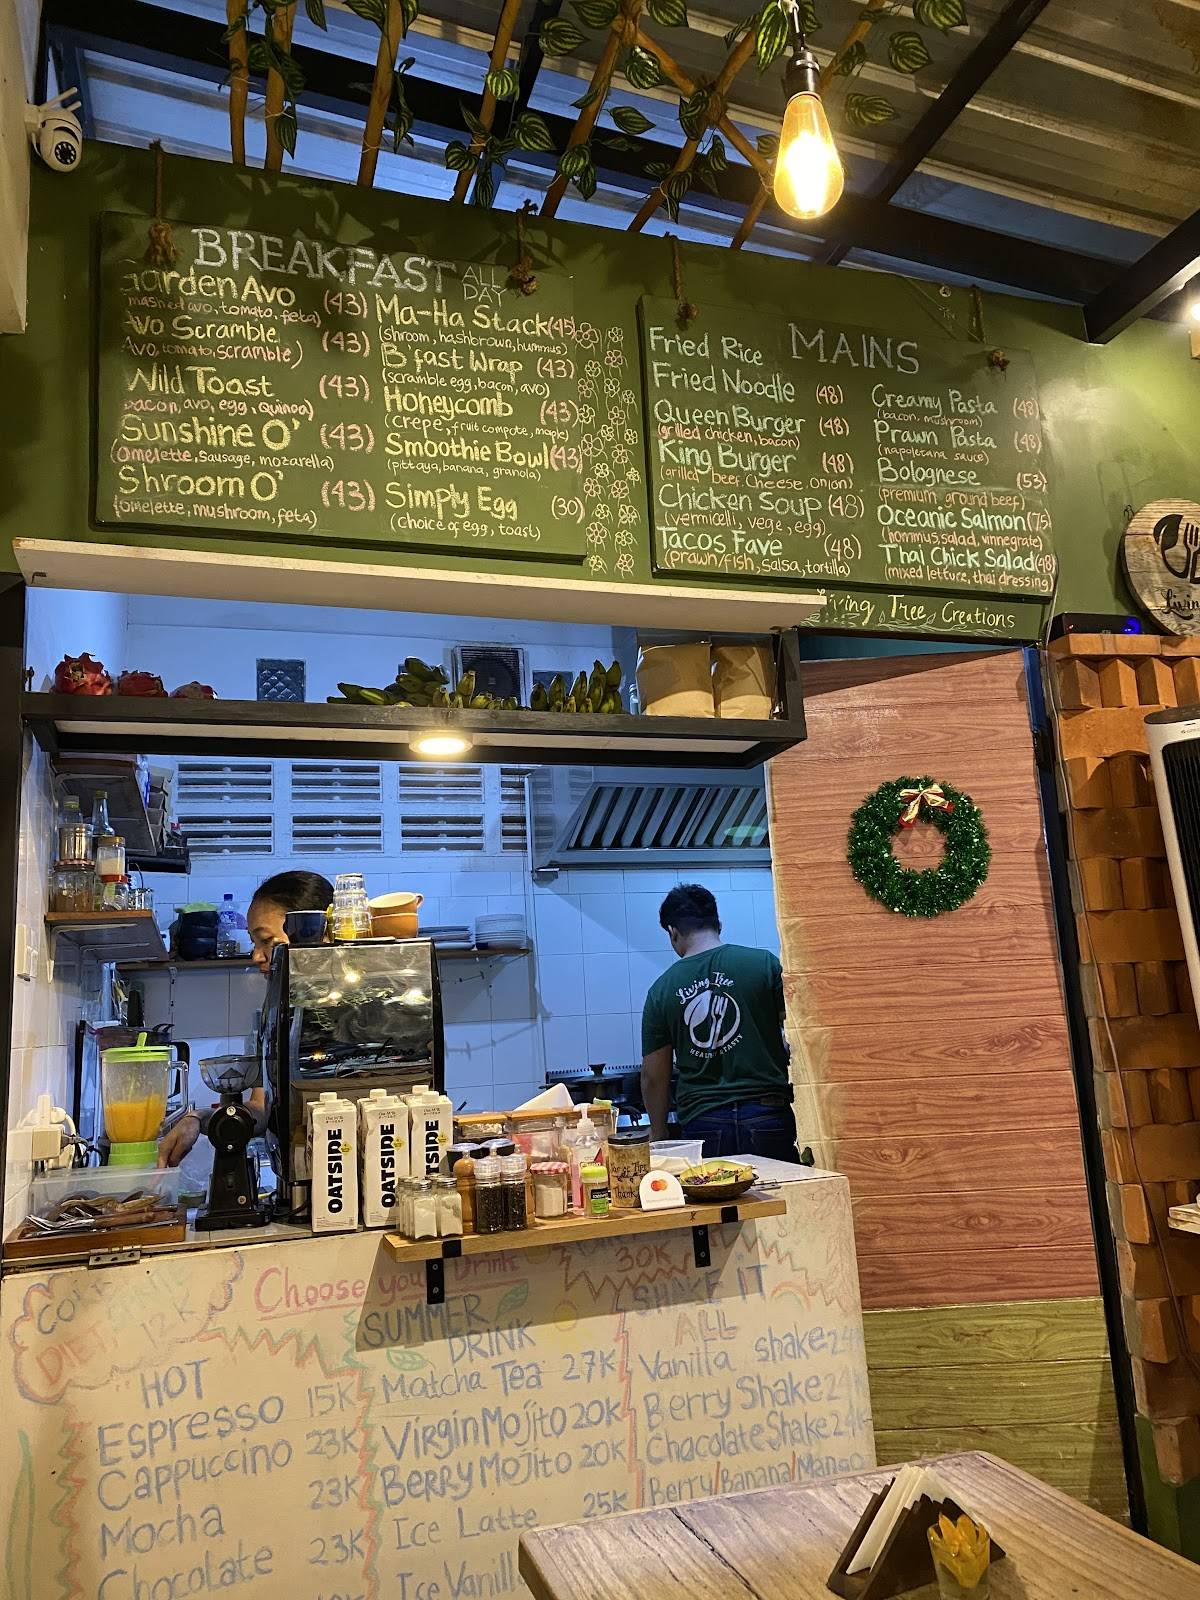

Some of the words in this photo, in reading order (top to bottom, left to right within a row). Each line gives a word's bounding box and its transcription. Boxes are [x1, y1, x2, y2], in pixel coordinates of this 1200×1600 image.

[191, 228, 456, 293] BREAKFAST
[461, 265, 501, 288] ALL
[241, 275, 296, 307] Avo
[323, 289, 368, 319] (43)
[463, 284, 508, 307] DAY
[376, 294, 466, 328] Ma-Ha
[472, 304, 548, 338] Stack
[547, 315, 577, 339] (45)
[171, 314, 280, 343] Scramble
[322, 331, 371, 359] (43)
[216, 340, 304, 369] scramble)
[378, 325, 438, 345] (shroom,
[517, 343, 568, 356] hummus)
[649, 327, 711, 359] Fried
[721, 336, 764, 367] Rice
[788, 322, 920, 375] MAINS
[184, 365, 276, 397] Toast
[319, 374, 371, 402] (43)
[382, 368, 448, 388] (scramble
[521, 382, 550, 399] avo)
[469, 349, 524, 384] Wrap
[536, 357, 575, 380] (43)
[652, 360, 718, 394] Fried
[722, 368, 796, 404] Noodle
[815, 384, 844, 406] (48)
[384, 385, 513, 420] Honeycomb
[539, 399, 579, 427] (43)
[653, 399, 729, 426] Queen
[732, 404, 806, 438] Burger
[818, 416, 850, 437] (48)
[872, 384, 942, 418] Creamy
[948, 388, 999, 415] Pasta
[1012, 397, 1041, 419] (48)
[121, 413, 256, 448] Sunshine
[319, 422, 375, 453] (43)
[384, 413, 451, 439] (crepe,
[451, 422, 480, 436] fruit
[657, 422, 701, 440] (grilled
[758, 435, 801, 451] bacon)
[874, 418, 939, 446] Prawn
[949, 425, 998, 449] Pasta
[1014, 430, 1042, 455] (48)
[924, 414, 984, 428] mushroom)
[259, 455, 335, 473] mozarella)
[385, 432, 492, 462] Smoothie
[495, 440, 549, 470] Bowl
[549, 446, 583, 474] (43)
[657, 440, 713, 475] King
[717, 442, 797, 478] Burger
[821, 451, 855, 475] (48)
[953, 450, 990, 466] sauce)
[118, 463, 245, 498] Shroom
[320, 479, 376, 512] (43)
[493, 466, 542, 482] granola)
[660, 465, 700, 482] (grilled
[877, 456, 982, 488] Bolognese
[1016, 471, 1048, 494] (53)
[385, 482, 470, 519] Simply
[477, 486, 518, 521] Egg
[551, 495, 586, 524] (30)
[658, 483, 753, 512] Chicken
[758, 491, 823, 524] Soup
[827, 494, 865, 519] (48)
[876, 504, 958, 530] Oceanic
[961, 507, 1027, 531] Salmon
[1026, 508, 1052, 531] (75)
[878, 486, 938, 506] (premium
[944, 488, 989, 508] ground
[990, 492, 1026, 511] beef)
[277, 508, 318, 530] feta)
[447, 521, 460, 538] of
[499, 521, 542, 542] toast)
[664, 510, 743, 530] (vermicelli,
[794, 520, 826, 539] egg)
[656, 525, 726, 554] Tacos
[731, 529, 783, 557] Fave
[823, 534, 862, 562] (48)
[877, 543, 924, 567] Thai
[930, 545, 981, 569] Chick
[984, 548, 1035, 573] Salad
[1034, 552, 1057, 575] (48)
[806, 559, 851, 577] tortilla)
[884, 563, 924, 581] (mixed
[972, 569, 997, 585] thai
[998, 570, 1054, 592] dressing)
[887, 594, 927, 621] Tree
[941, 601, 1016, 629] Creations
[675, 977, 710, 1005] Living
[711, 971, 735, 988] Tree
[380, 1123, 397, 1209] OATSIDE
[425, 1119, 440, 1176] TSIDE
[327, 1128, 343, 1214] OATSIDE
[616, 1239, 672, 1274] 30K
[254, 1267, 366, 1313] Choose
[453, 1252, 521, 1281] Drink
[363, 1293, 489, 1348] SUMMER
[674, 1308, 738, 1347] ALL
[448, 1318, 537, 1365] DRINK
[140, 1357, 209, 1409] HOT
[381, 1368, 488, 1404] Matcha
[491, 1360, 544, 1397] Tea
[561, 1348, 616, 1383] 27K
[639, 1344, 736, 1384] Vanilla
[98, 1395, 284, 1467] Espresso
[307, 1381, 356, 1418] 15K
[569, 1397, 622, 1430] 20K
[644, 1385, 731, 1431] Berry
[98, 1437, 293, 1511] Cappuccino
[305, 1425, 360, 1460] 23K
[580, 1439, 628, 1469] 20K
[101, 1503, 226, 1560] Mocha
[308, 1474, 361, 1510] 23K
[393, 1516, 442, 1551] Ice
[456, 1506, 540, 1540] Latte
[582, 1489, 628, 1518] 25K
[308, 1527, 366, 1565] 23K
